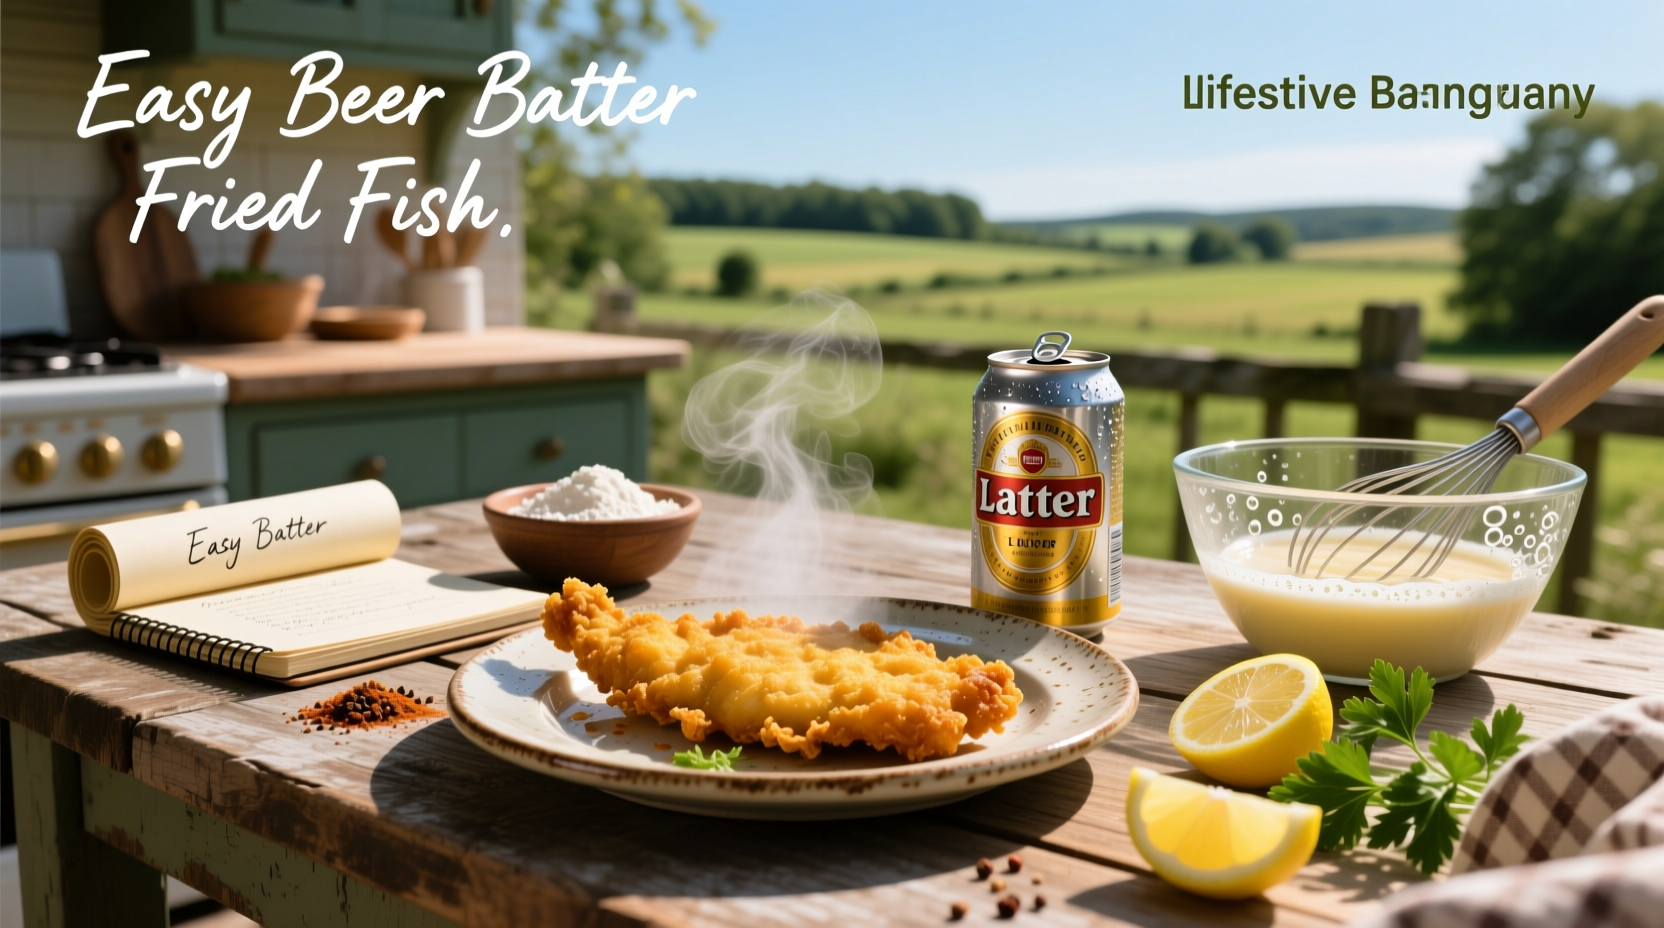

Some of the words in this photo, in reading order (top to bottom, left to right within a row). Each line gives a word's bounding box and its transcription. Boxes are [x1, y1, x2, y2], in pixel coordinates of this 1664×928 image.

[979, 477, 1096, 518] Latter
[186, 526, 242, 569] Easy
[252, 516, 328, 550] Batter
